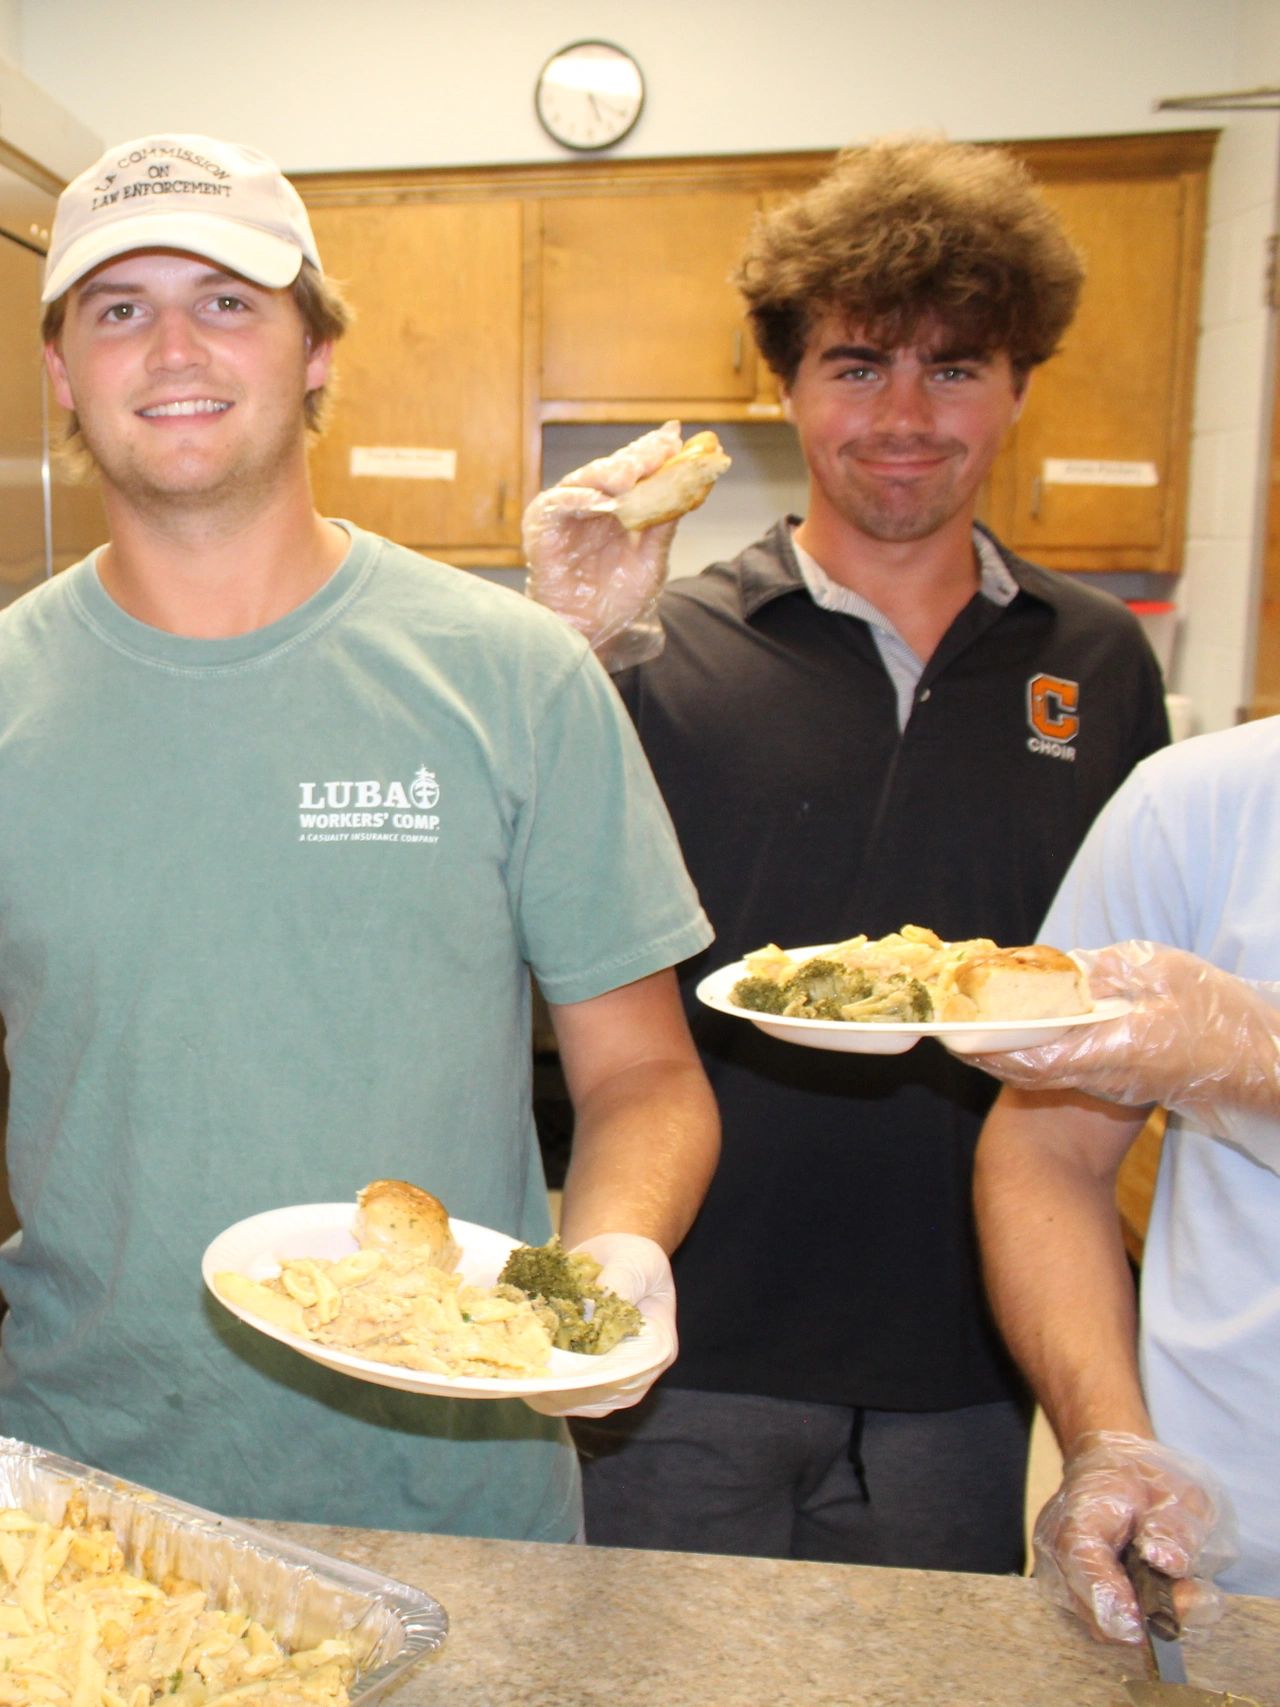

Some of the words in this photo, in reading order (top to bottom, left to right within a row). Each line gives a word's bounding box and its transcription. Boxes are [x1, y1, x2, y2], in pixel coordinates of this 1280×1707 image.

[118, 148, 232, 180] COMMISSION
[147, 165, 170, 179] ON
[92, 192, 120, 211] LAW
[123, 180, 232, 199] ENFORCEMENT
[1026, 672, 1080, 744] C
[299, 780, 412, 809] LUBA
[299, 813, 389, 829] WORKERS'
[392, 814, 441, 831] COMP.
[299, 833, 306, 842] A
[308, 833, 349, 842] CASUALTY
[350, 833, 398, 842] INSURANCE
[400, 834, 439, 844] COMPANY
